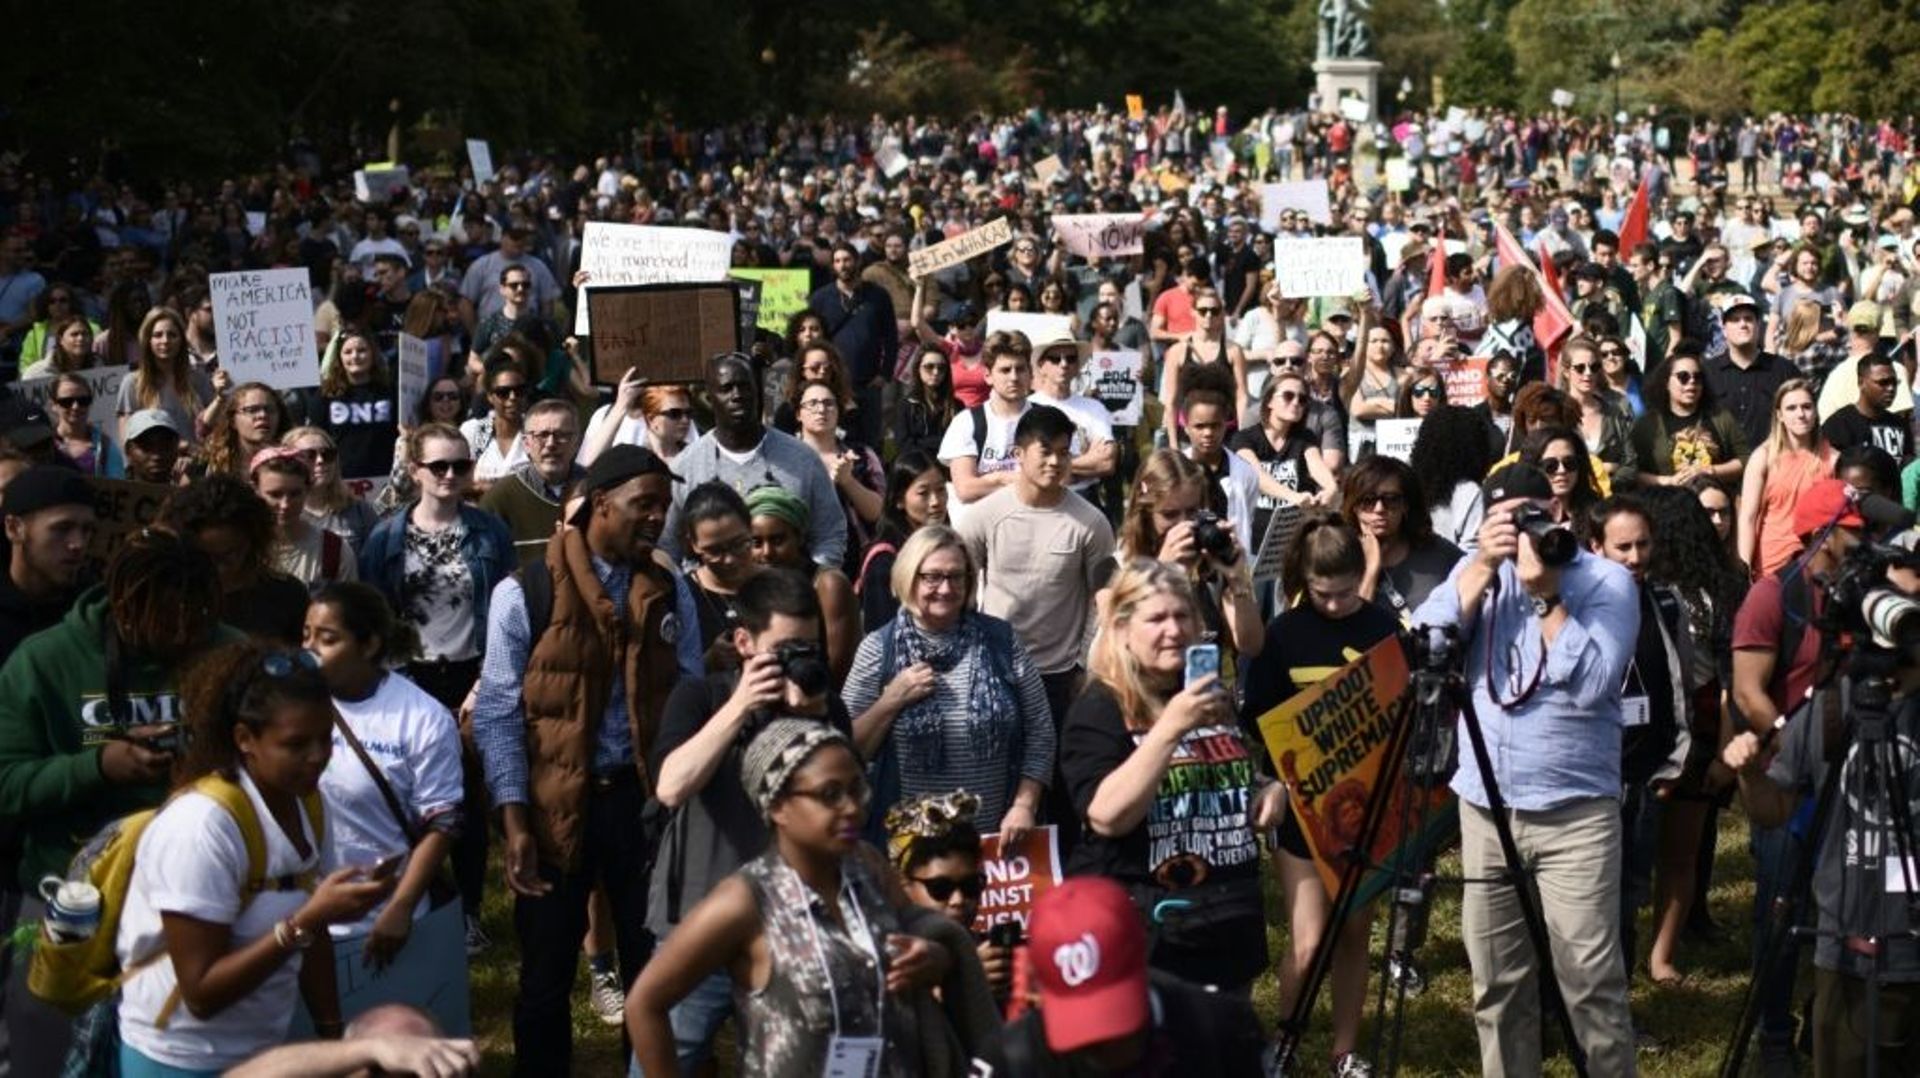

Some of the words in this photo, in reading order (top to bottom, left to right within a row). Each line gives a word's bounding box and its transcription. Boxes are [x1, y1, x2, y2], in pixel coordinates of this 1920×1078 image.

[622, 248, 689, 269] marched
[226, 282, 307, 307] AMERICA
[226, 311, 258, 331] NOT
[229, 324, 306, 350] RACIST
[1103, 366, 1131, 385] end
[1440, 369, 1482, 384] TAND
[1098, 383, 1133, 395] white
[1296, 656, 1374, 737] UPROOT
[81, 695, 186, 727] GM
[1313, 688, 1380, 755] WHITE
[1297, 695, 1402, 806] SUPREMAC
[984, 856, 1030, 885] ND
[981, 884, 1033, 908] INST
